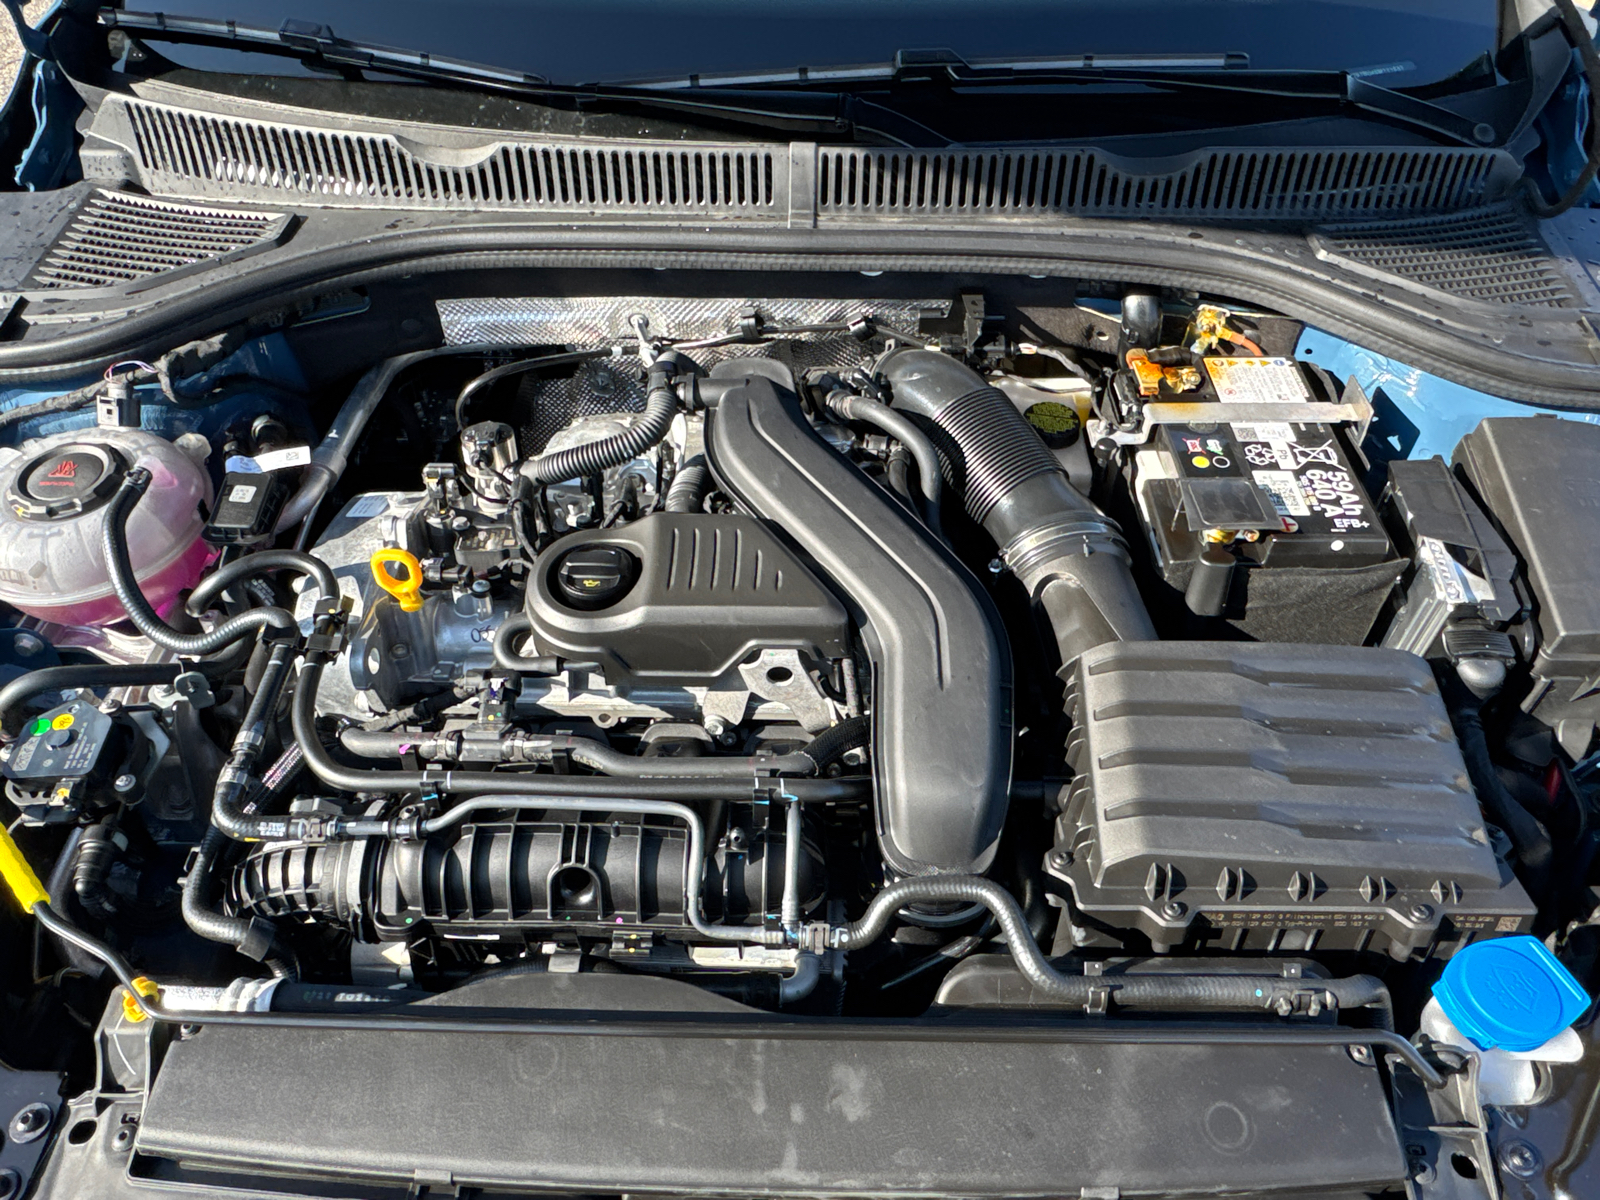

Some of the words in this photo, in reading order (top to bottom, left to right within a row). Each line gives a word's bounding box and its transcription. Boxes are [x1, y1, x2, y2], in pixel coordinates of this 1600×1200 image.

[1278, 449, 1289, 460] Pb
[1306, 469, 1337, 500] 640
[1327, 471, 1364, 516] 59Ah
[1320, 503, 1345, 518] A
[1333, 518, 1370, 528] EFB+
